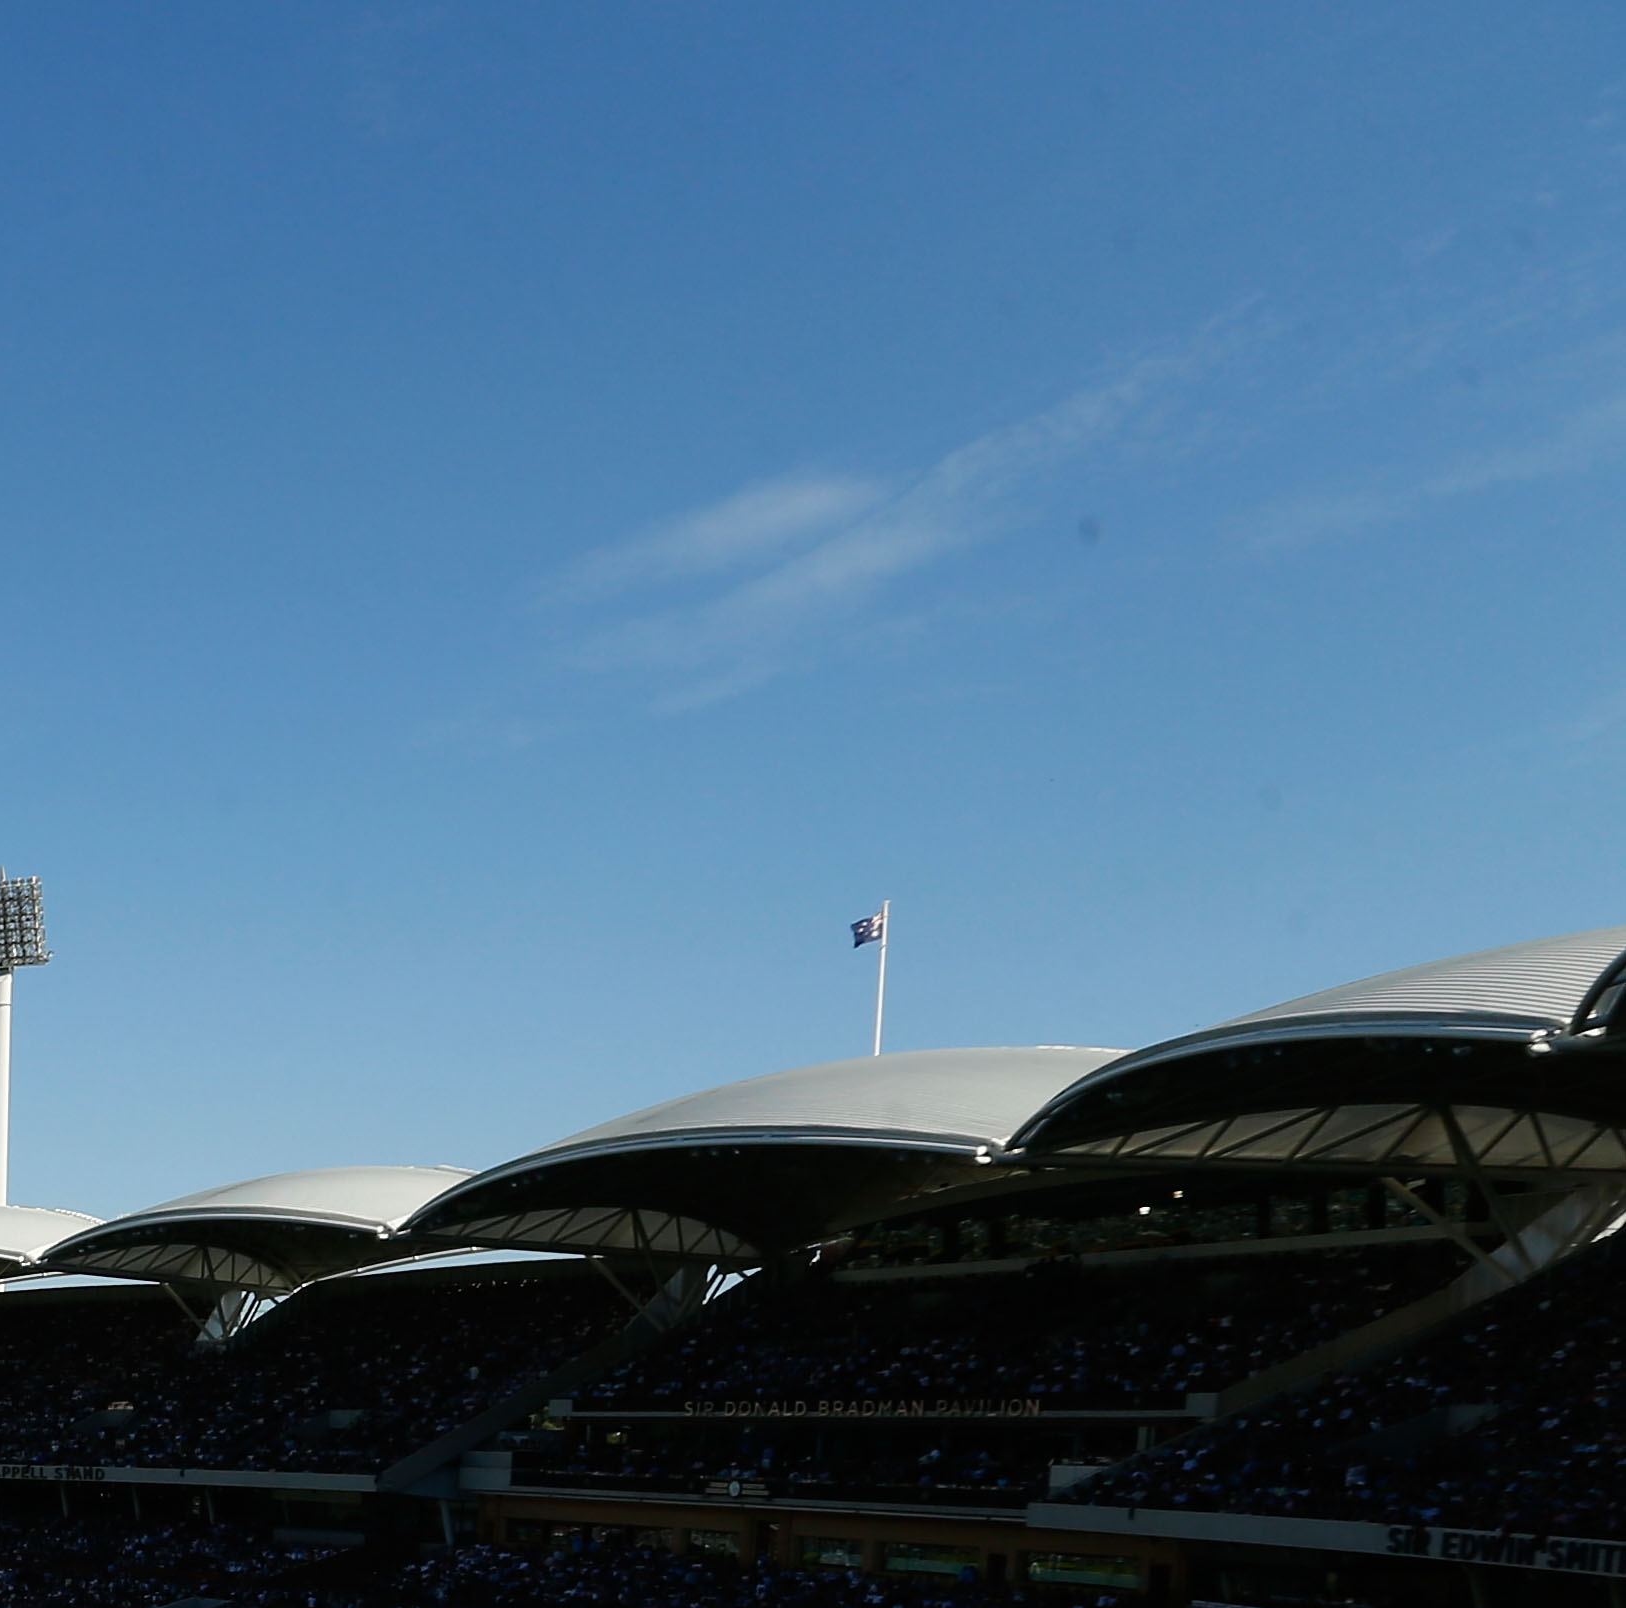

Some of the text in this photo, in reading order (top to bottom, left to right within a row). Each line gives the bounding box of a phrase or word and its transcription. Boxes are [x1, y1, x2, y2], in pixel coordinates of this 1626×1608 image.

[684, 1399, 1042, 1417] SIR DONALD BRADMAN PAVILION
[54, 1467, 106, 1480] STAND
[1386, 1527, 1430, 1554] SIR
[1442, 1532, 1535, 1566] EDWIN
